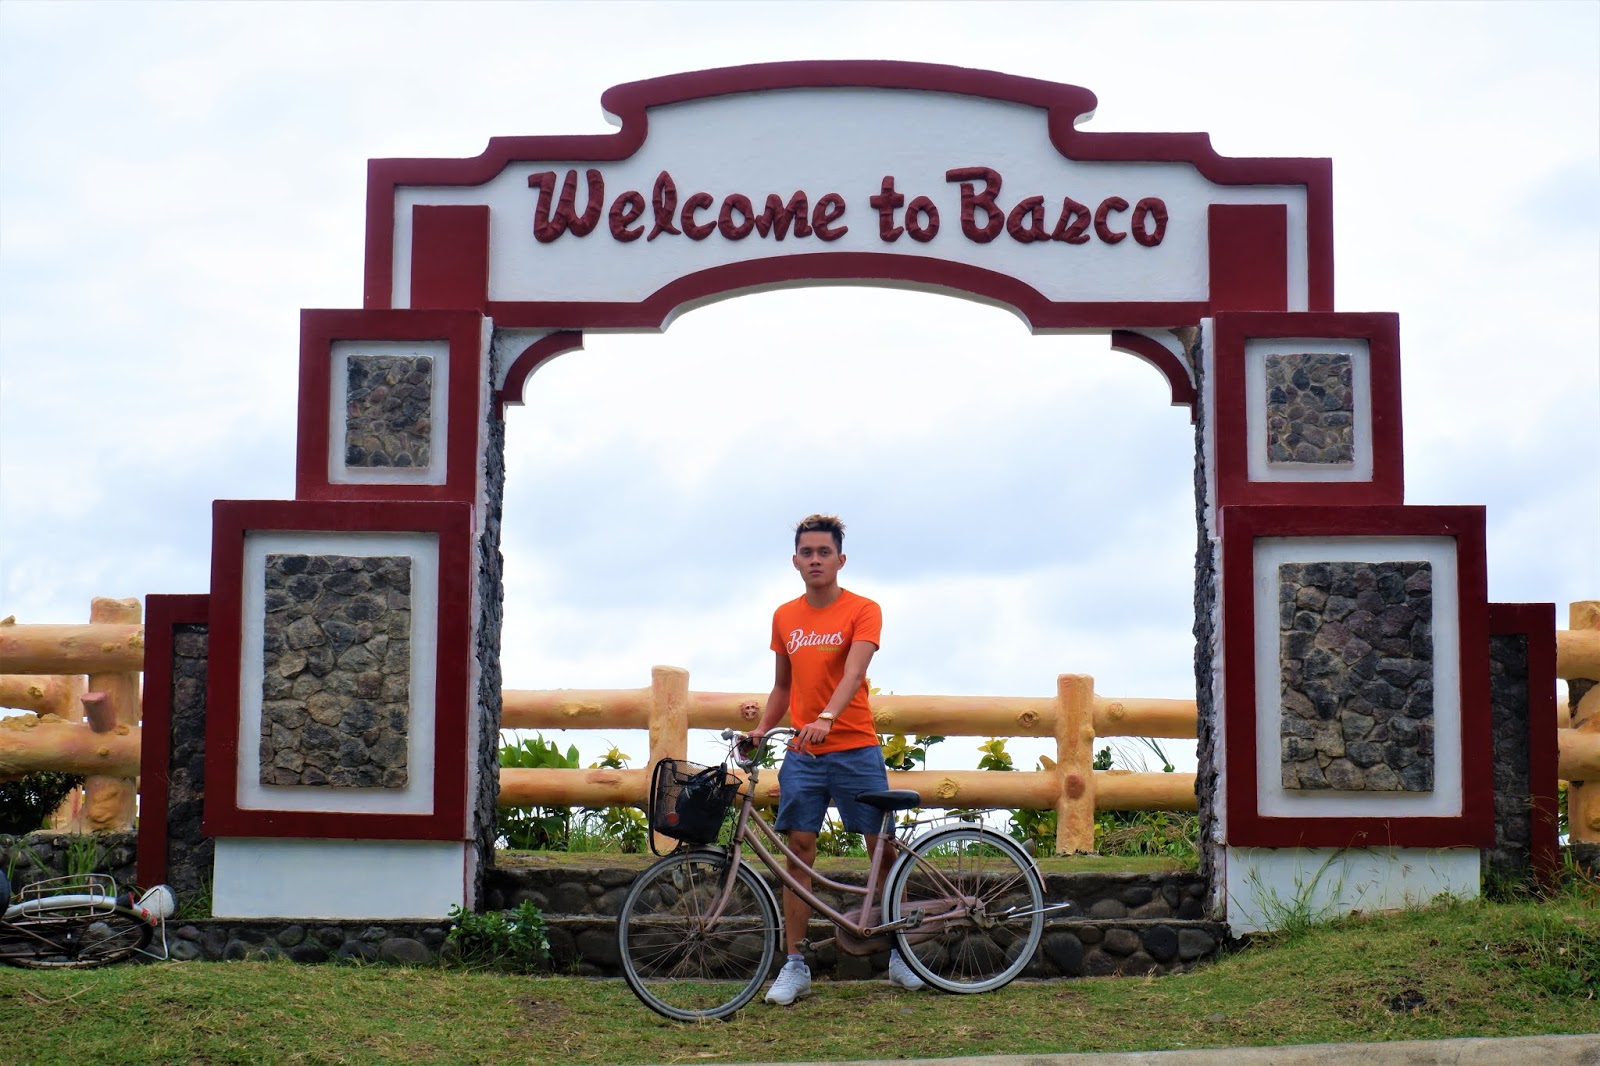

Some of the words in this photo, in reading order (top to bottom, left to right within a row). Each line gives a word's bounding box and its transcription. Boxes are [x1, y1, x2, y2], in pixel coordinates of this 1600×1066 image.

[528, 169, 848, 243] Welcome
[870, 176, 940, 242] to
[946, 167, 1168, 247] Basco
[787, 629, 845, 654] Batanes
